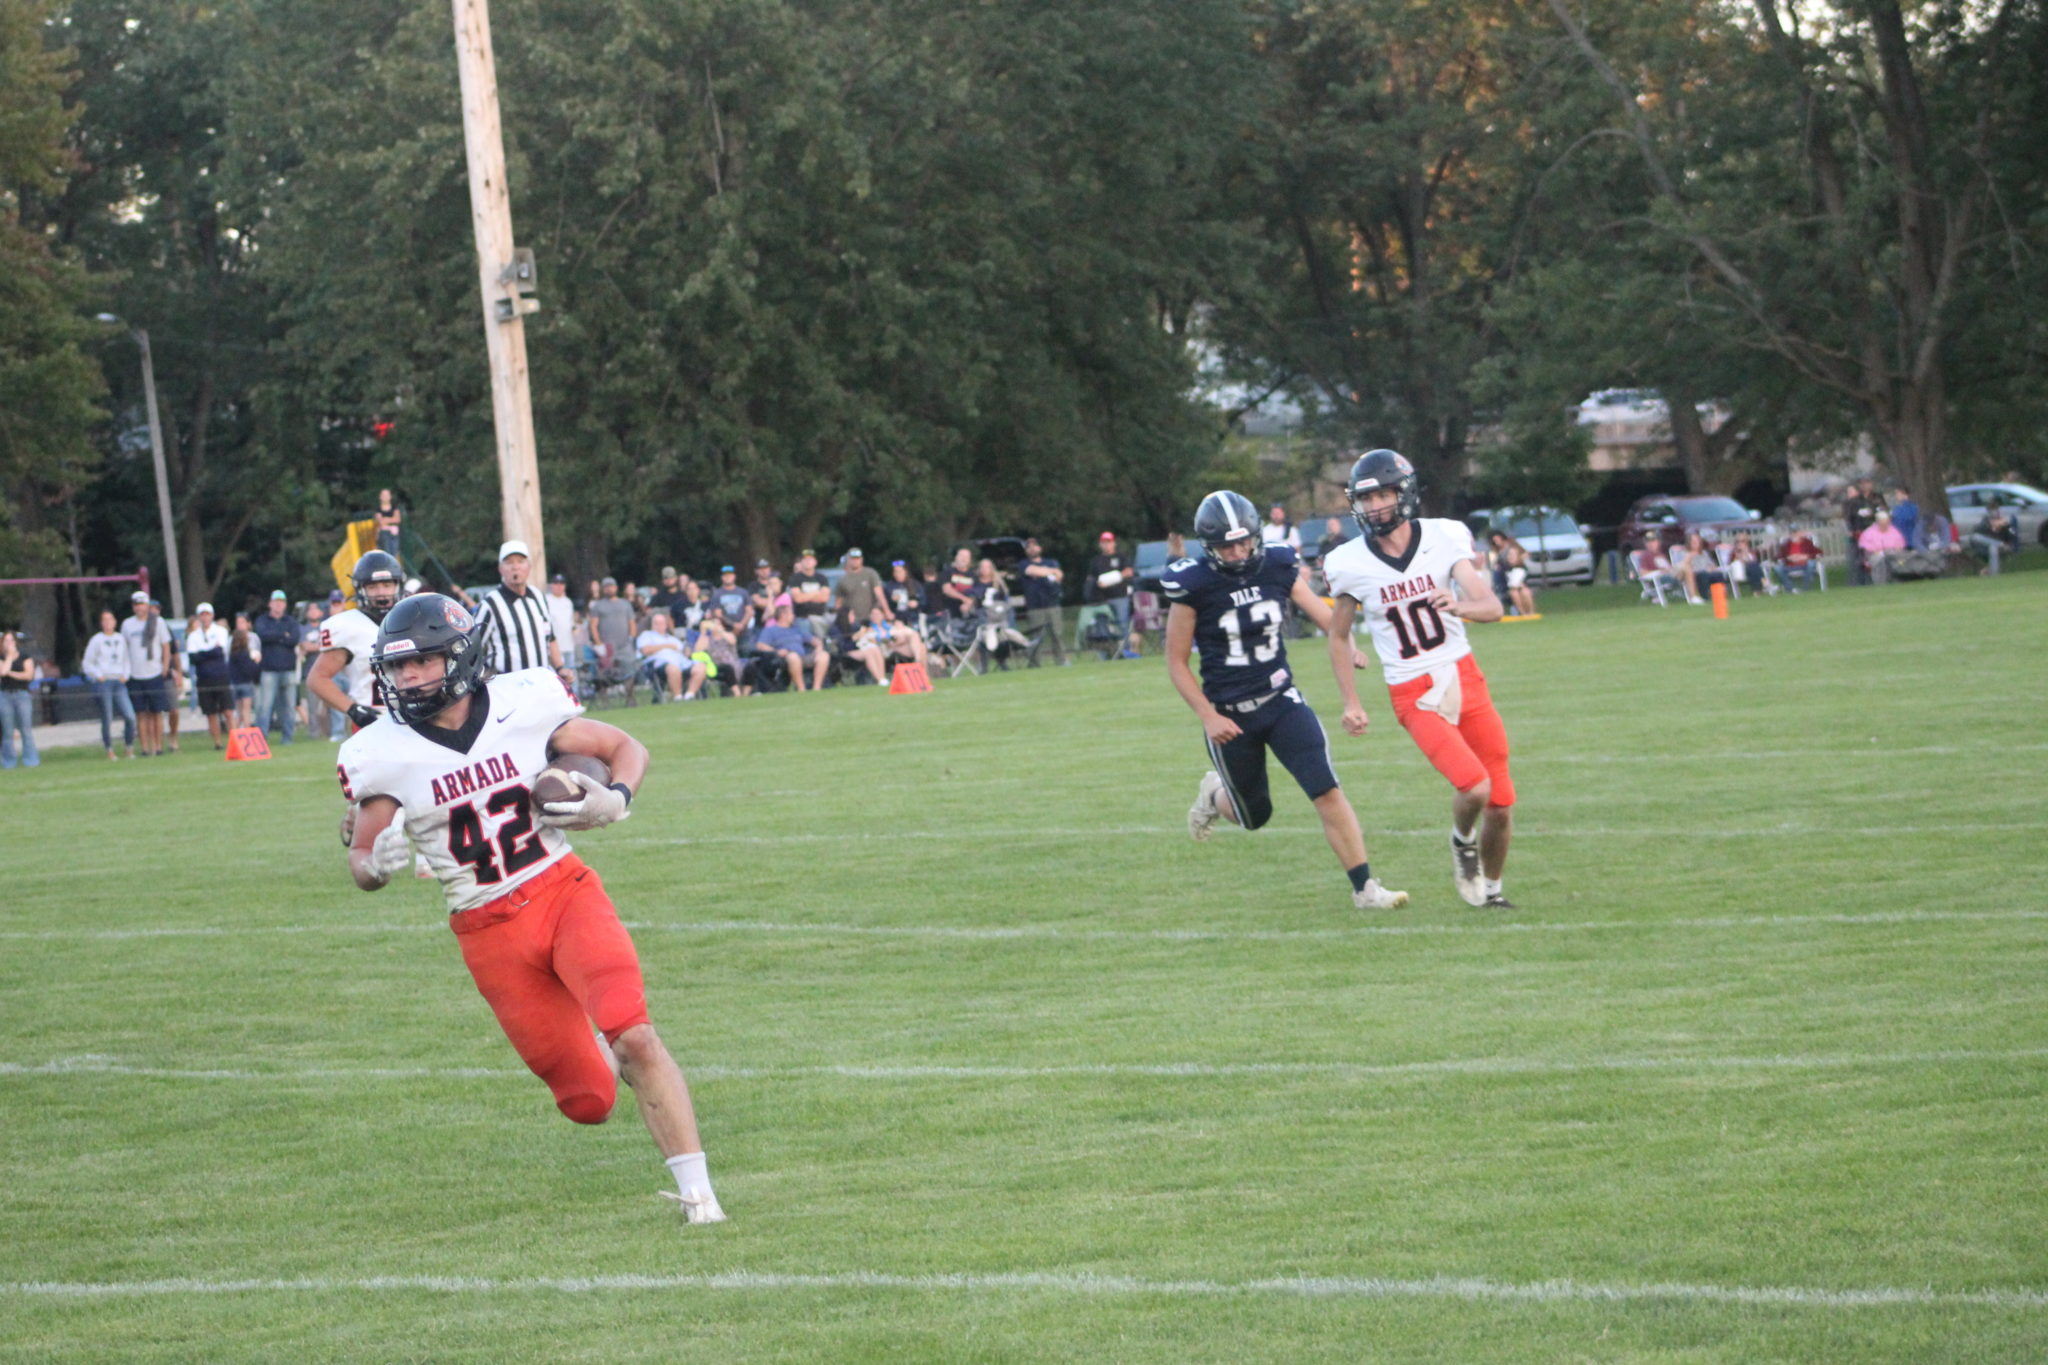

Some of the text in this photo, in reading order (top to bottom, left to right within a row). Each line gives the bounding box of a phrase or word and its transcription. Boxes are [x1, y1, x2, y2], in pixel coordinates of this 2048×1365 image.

[1229, 586, 1263, 607] YALE
[1379, 573, 1436, 605] ARMADA
[1218, 599, 1283, 666] 13
[1385, 598, 1446, 660] 10
[904, 668, 928, 691] 10
[237, 732, 268, 758] 20
[431, 752, 521, 807] ARMADA
[447, 783, 551, 886] 42
